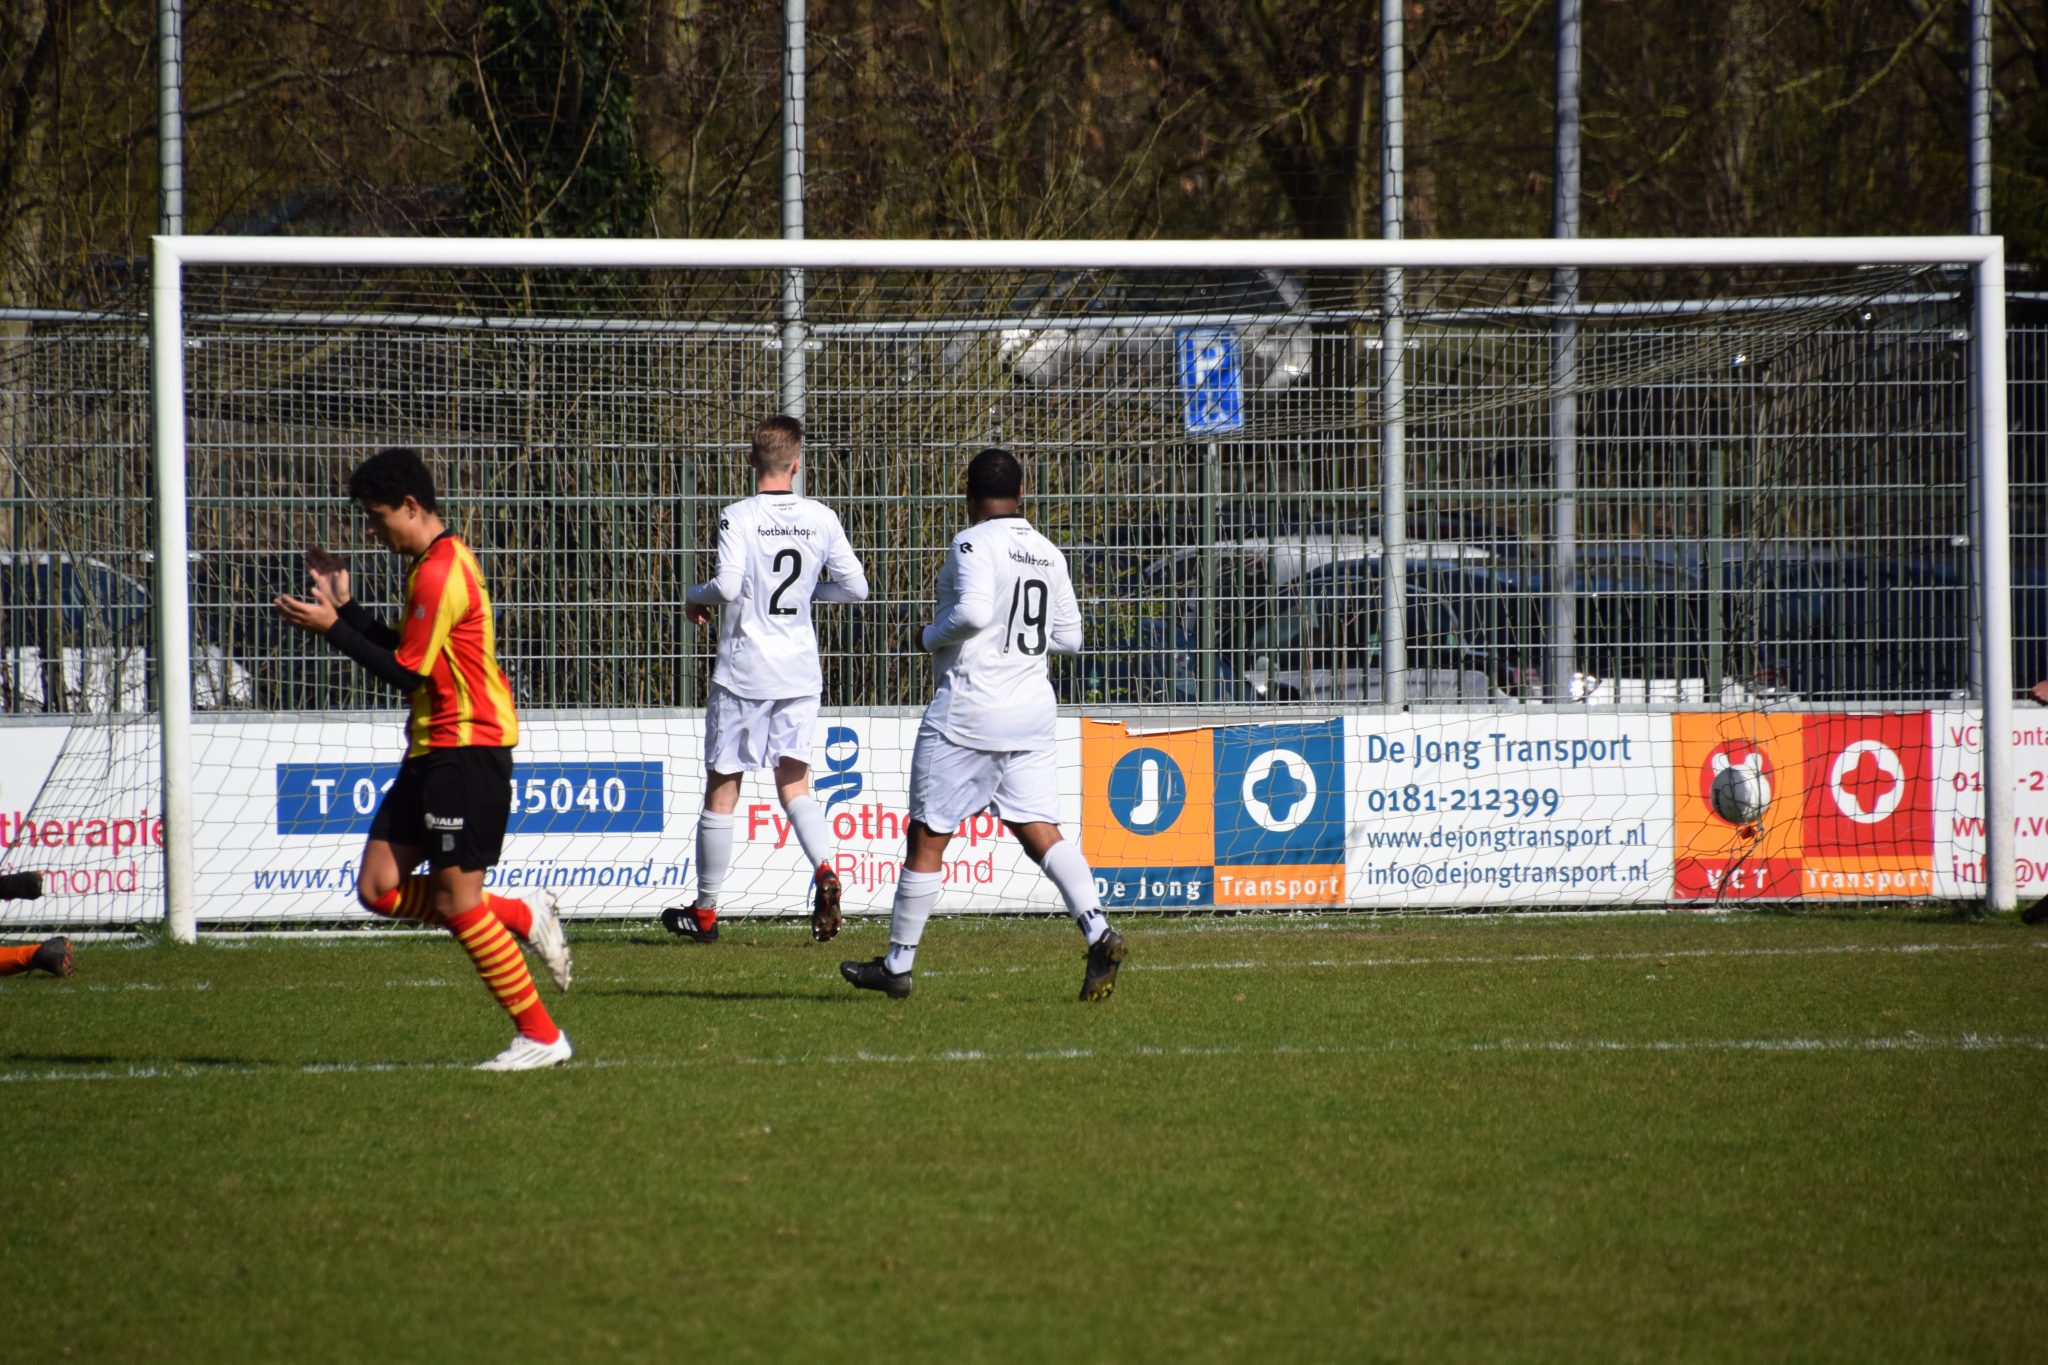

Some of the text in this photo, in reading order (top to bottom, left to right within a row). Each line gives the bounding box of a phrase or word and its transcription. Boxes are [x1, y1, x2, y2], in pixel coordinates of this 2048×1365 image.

[1195, 338, 1226, 385] P
[769, 548, 802, 615] 2
[1003, 576, 1048, 656] 19
[1368, 733, 1632, 769] De Jong Transport
[311, 779, 336, 815] T
[1130, 758, 1159, 825] J
[1368, 784, 1559, 818] 0181-212399
[1095, 877, 1201, 901] De Jong
[1220, 875, 1339, 900] Transport
[1706, 868, 1768, 890] VCT
[1806, 868, 1931, 892] Transport
